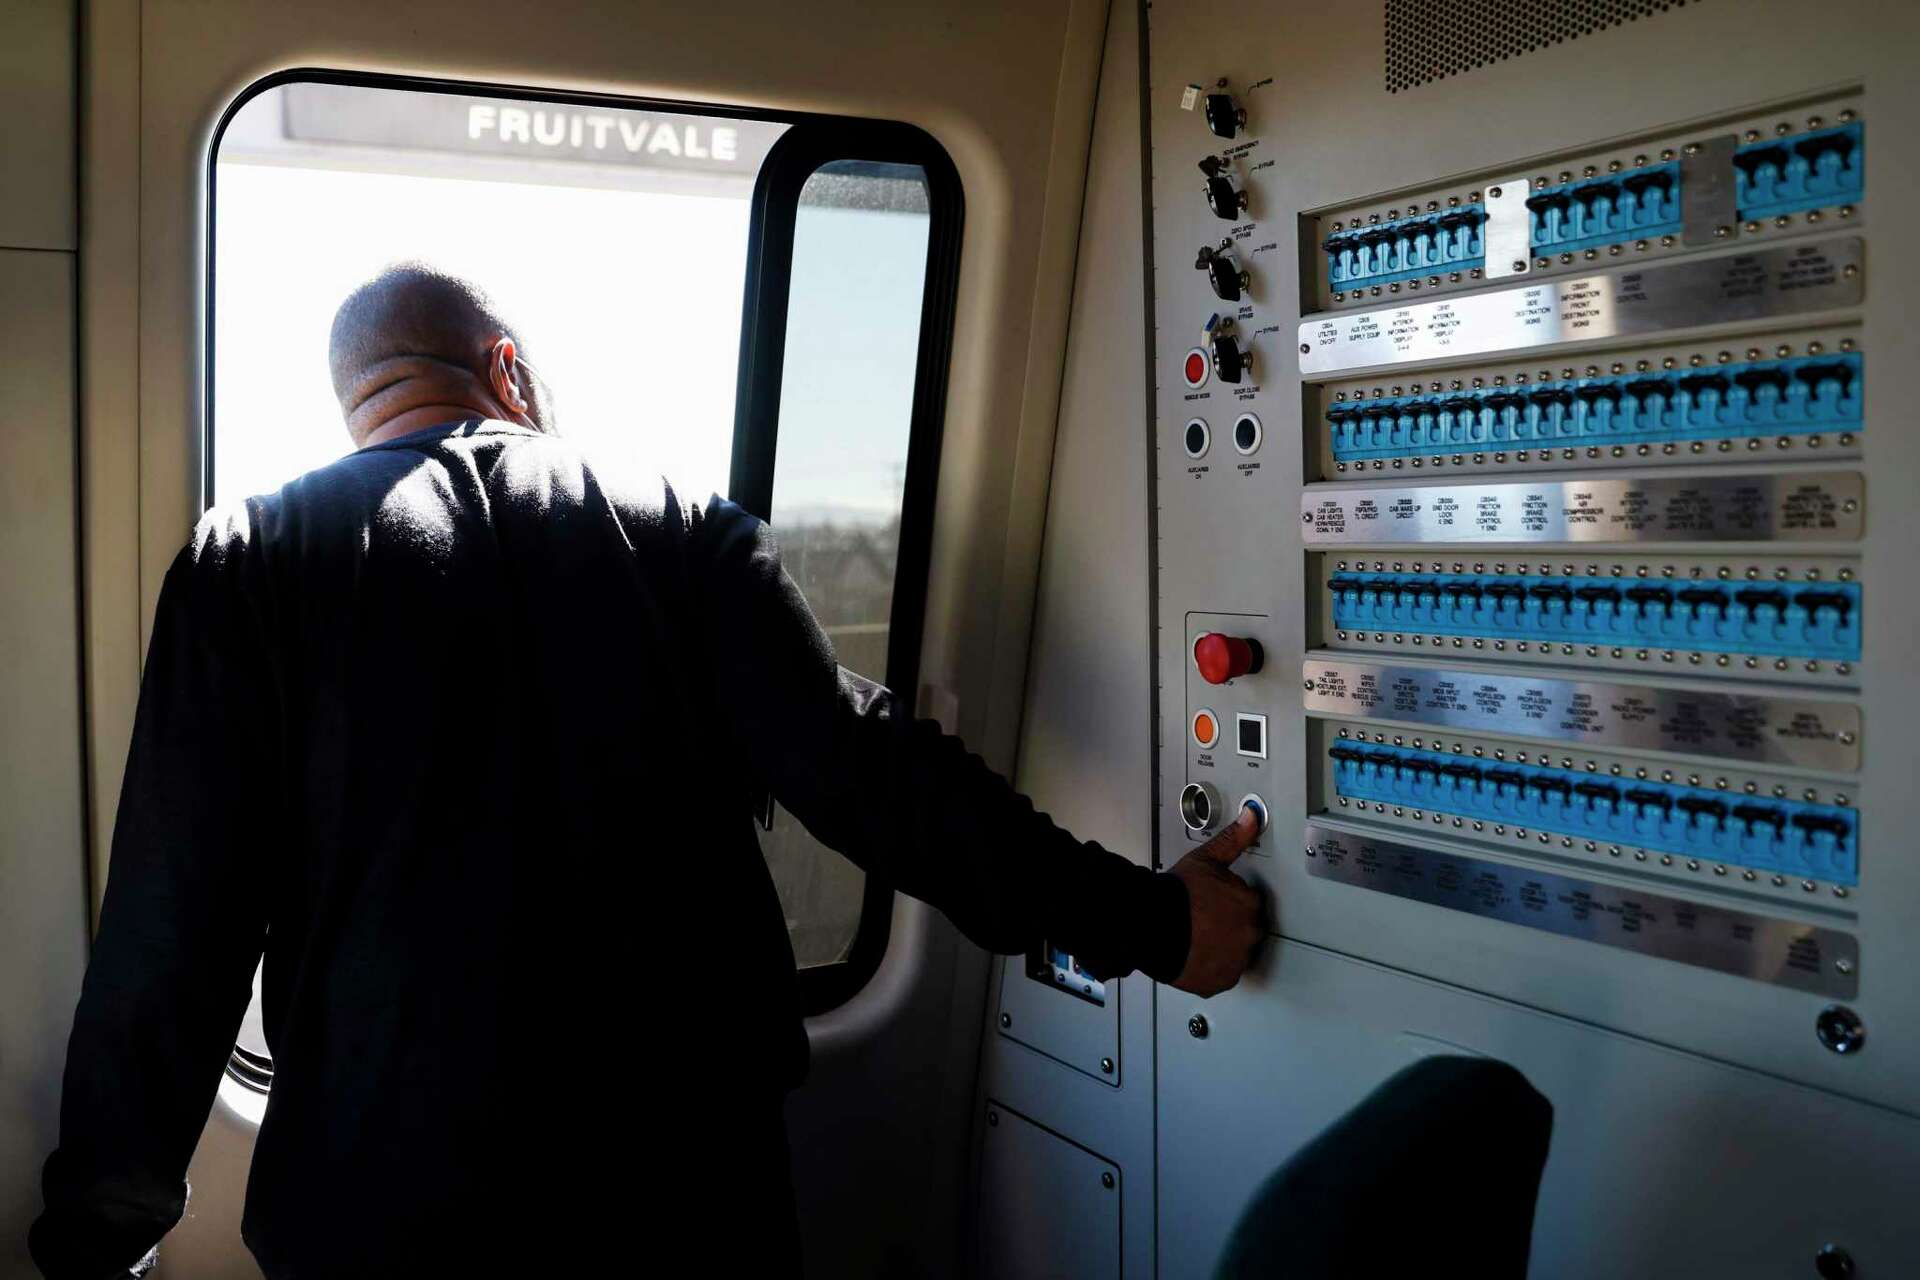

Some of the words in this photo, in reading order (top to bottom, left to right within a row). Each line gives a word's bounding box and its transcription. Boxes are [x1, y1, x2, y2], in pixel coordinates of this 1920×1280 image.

[468, 104, 738, 161] FRUITVALE
[1560, 290, 1600, 302] INFORMATION
[1515, 306, 1551, 317] DESTINATION
[1560, 310, 1600, 320] DESTINATION
[1428, 320, 1460, 329] INFORMATION
[1318, 329, 1337, 338] UTILITIES
[1388, 326, 1419, 336] INFORMATION
[1473, 691, 1506, 700] PROPULSION
[1517, 695, 1553, 705] PROPULSION
[1476, 698, 1502, 708] CONTROL
[1521, 703, 1548, 712] CONTROL
